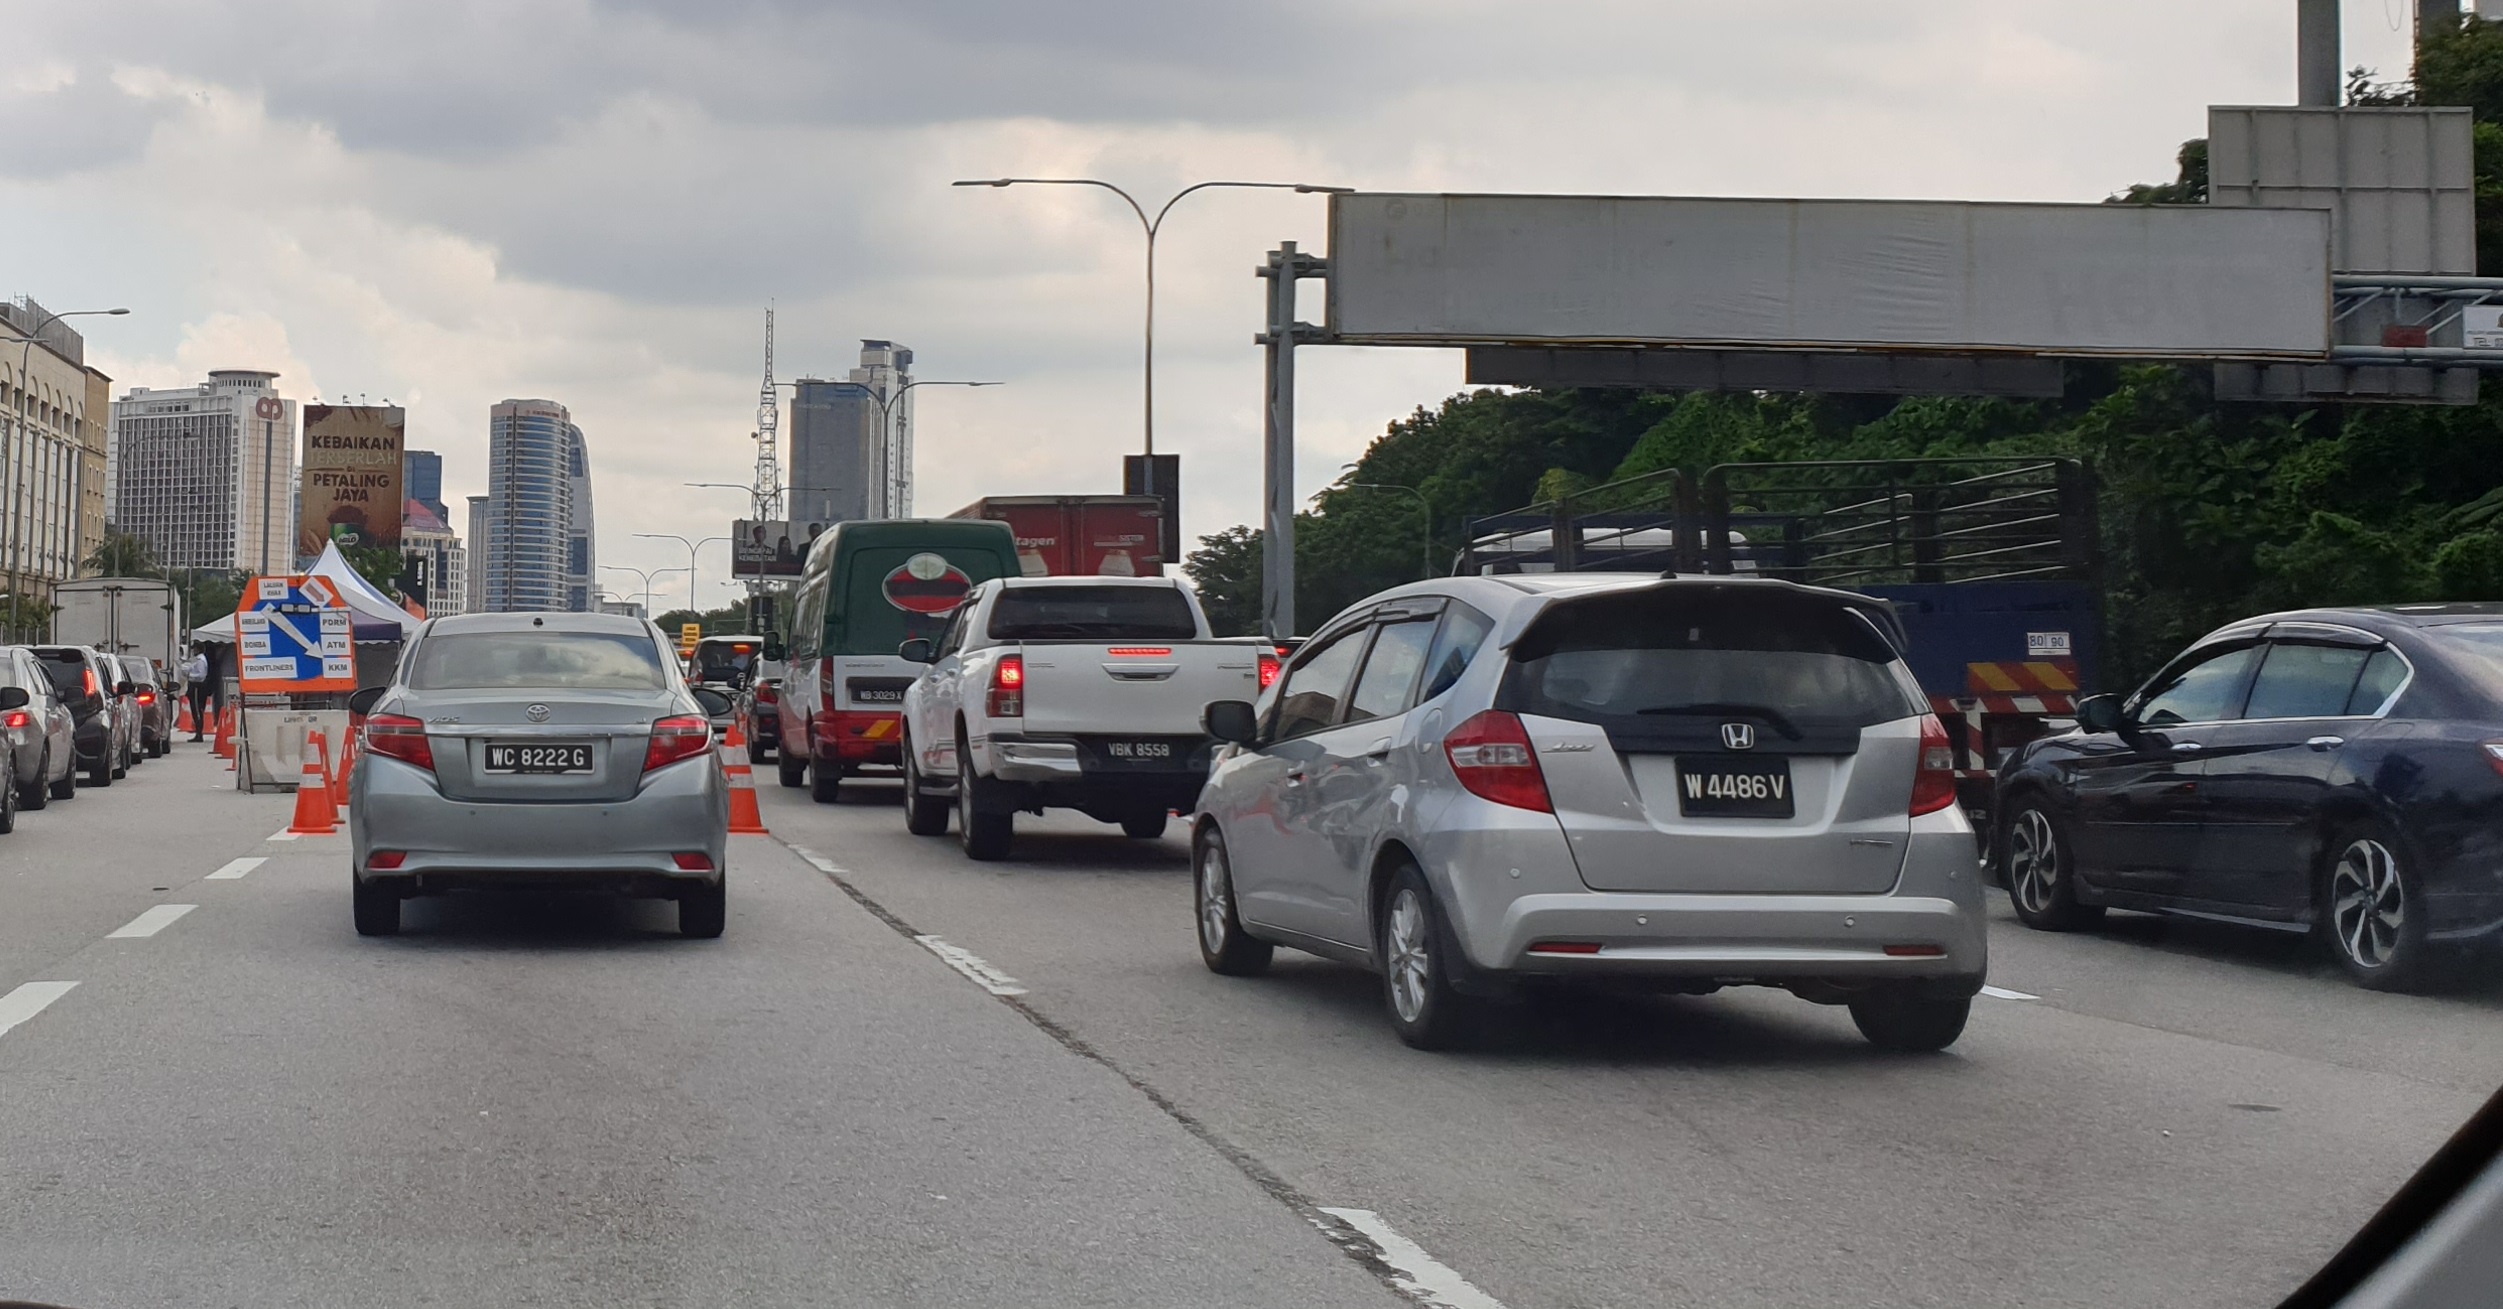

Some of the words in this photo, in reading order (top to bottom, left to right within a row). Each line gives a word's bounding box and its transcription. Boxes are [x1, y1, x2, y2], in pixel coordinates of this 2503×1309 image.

[311, 435, 395, 450] KEBAIKAN
[308, 449, 397, 465] TERSERLAH
[313, 473, 390, 488] PETALING
[332, 488, 369, 502] JAYA
[326, 641, 346, 649] ATM
[2030, 635, 2044, 647] 80
[328, 663, 348, 671] KKM
[872, 690, 896, 700] 3029
[492, 748, 515, 766] WC
[520, 748, 569, 766] 8222
[572, 748, 585, 766] G
[1108, 743, 1133, 756] VBK
[1136, 743, 1170, 757] 8558
[1684, 773, 1702, 799] W
[1707, 773, 1768, 799] 4486
[1768, 773, 1785, 799] V
